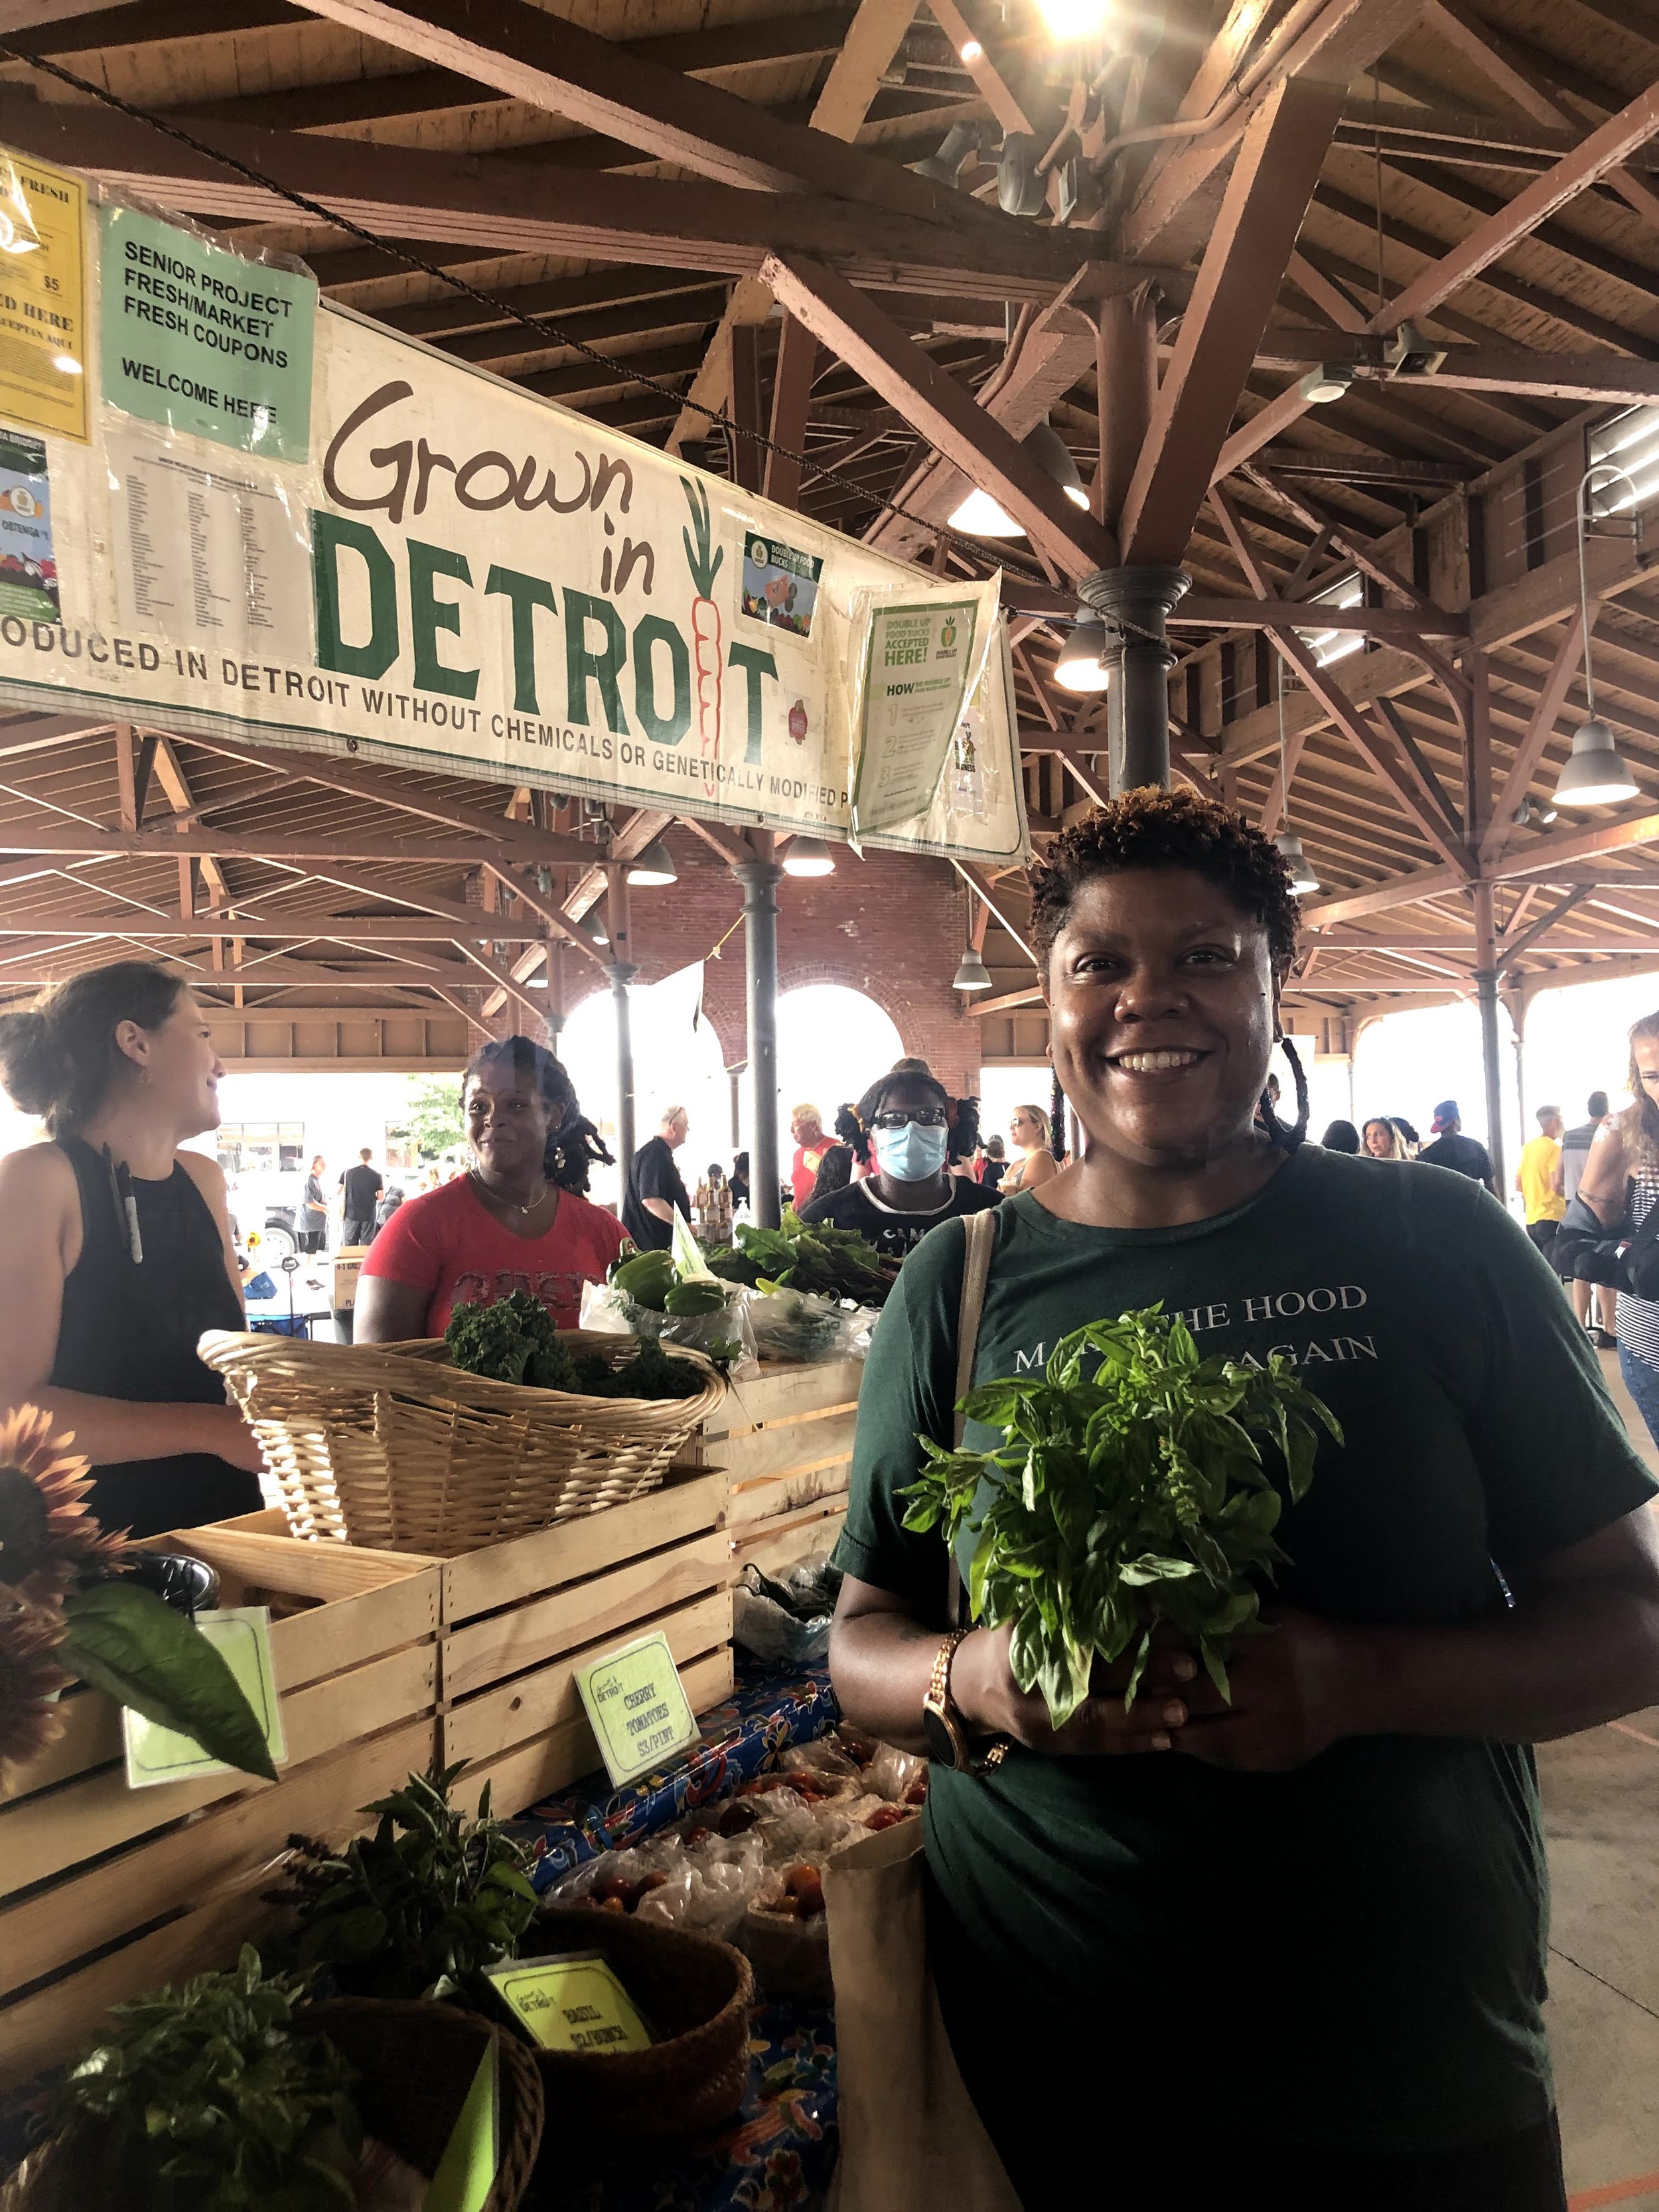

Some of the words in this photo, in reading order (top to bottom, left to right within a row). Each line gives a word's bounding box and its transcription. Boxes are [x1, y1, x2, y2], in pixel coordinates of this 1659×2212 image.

[44, 275, 60, 291] $5
[125, 241, 196, 287] SENIOR
[201, 273, 293, 318] PROJECT
[24, 302, 74, 332] HERE
[124, 267, 274, 339] FRESH/MARKET
[124, 295, 188, 336] FRESH
[194, 324, 288, 368] COUPONS
[121, 357, 218, 408] WELCOME
[323, 380, 632, 524] Grown
[601, 510, 655, 595] in
[770, 554, 788, 569] BUCKS
[771, 545, 792, 560] DOUBLE
[800, 556, 815, 569] FOOD
[313, 506, 779, 766] DETROIT
[886, 630, 906, 639] FOOD
[887, 619, 918, 630] DOUBLE
[920, 618, 931, 627] UP
[885, 637, 929, 650] ACCEPTED
[885, 647, 928, 667] HERE!
[887, 682, 915, 696] HOW
[175, 650, 208, 681] IN
[222, 658, 350, 708] DETROIT
[361, 687, 481, 733] WITHOUT
[491, 714, 613, 760] CHEMICALS
[620, 743, 646, 767] OR
[652, 750, 764, 791] GENETICALLY
[770, 776, 836, 806] MODIFIED
[1242, 1285, 1367, 1323] HOOD
[1241, 1335, 1378, 1371] AGAIN
[624, 1682, 656, 1710] CHERRY
[626, 1702, 670, 1736] TOMATOES
